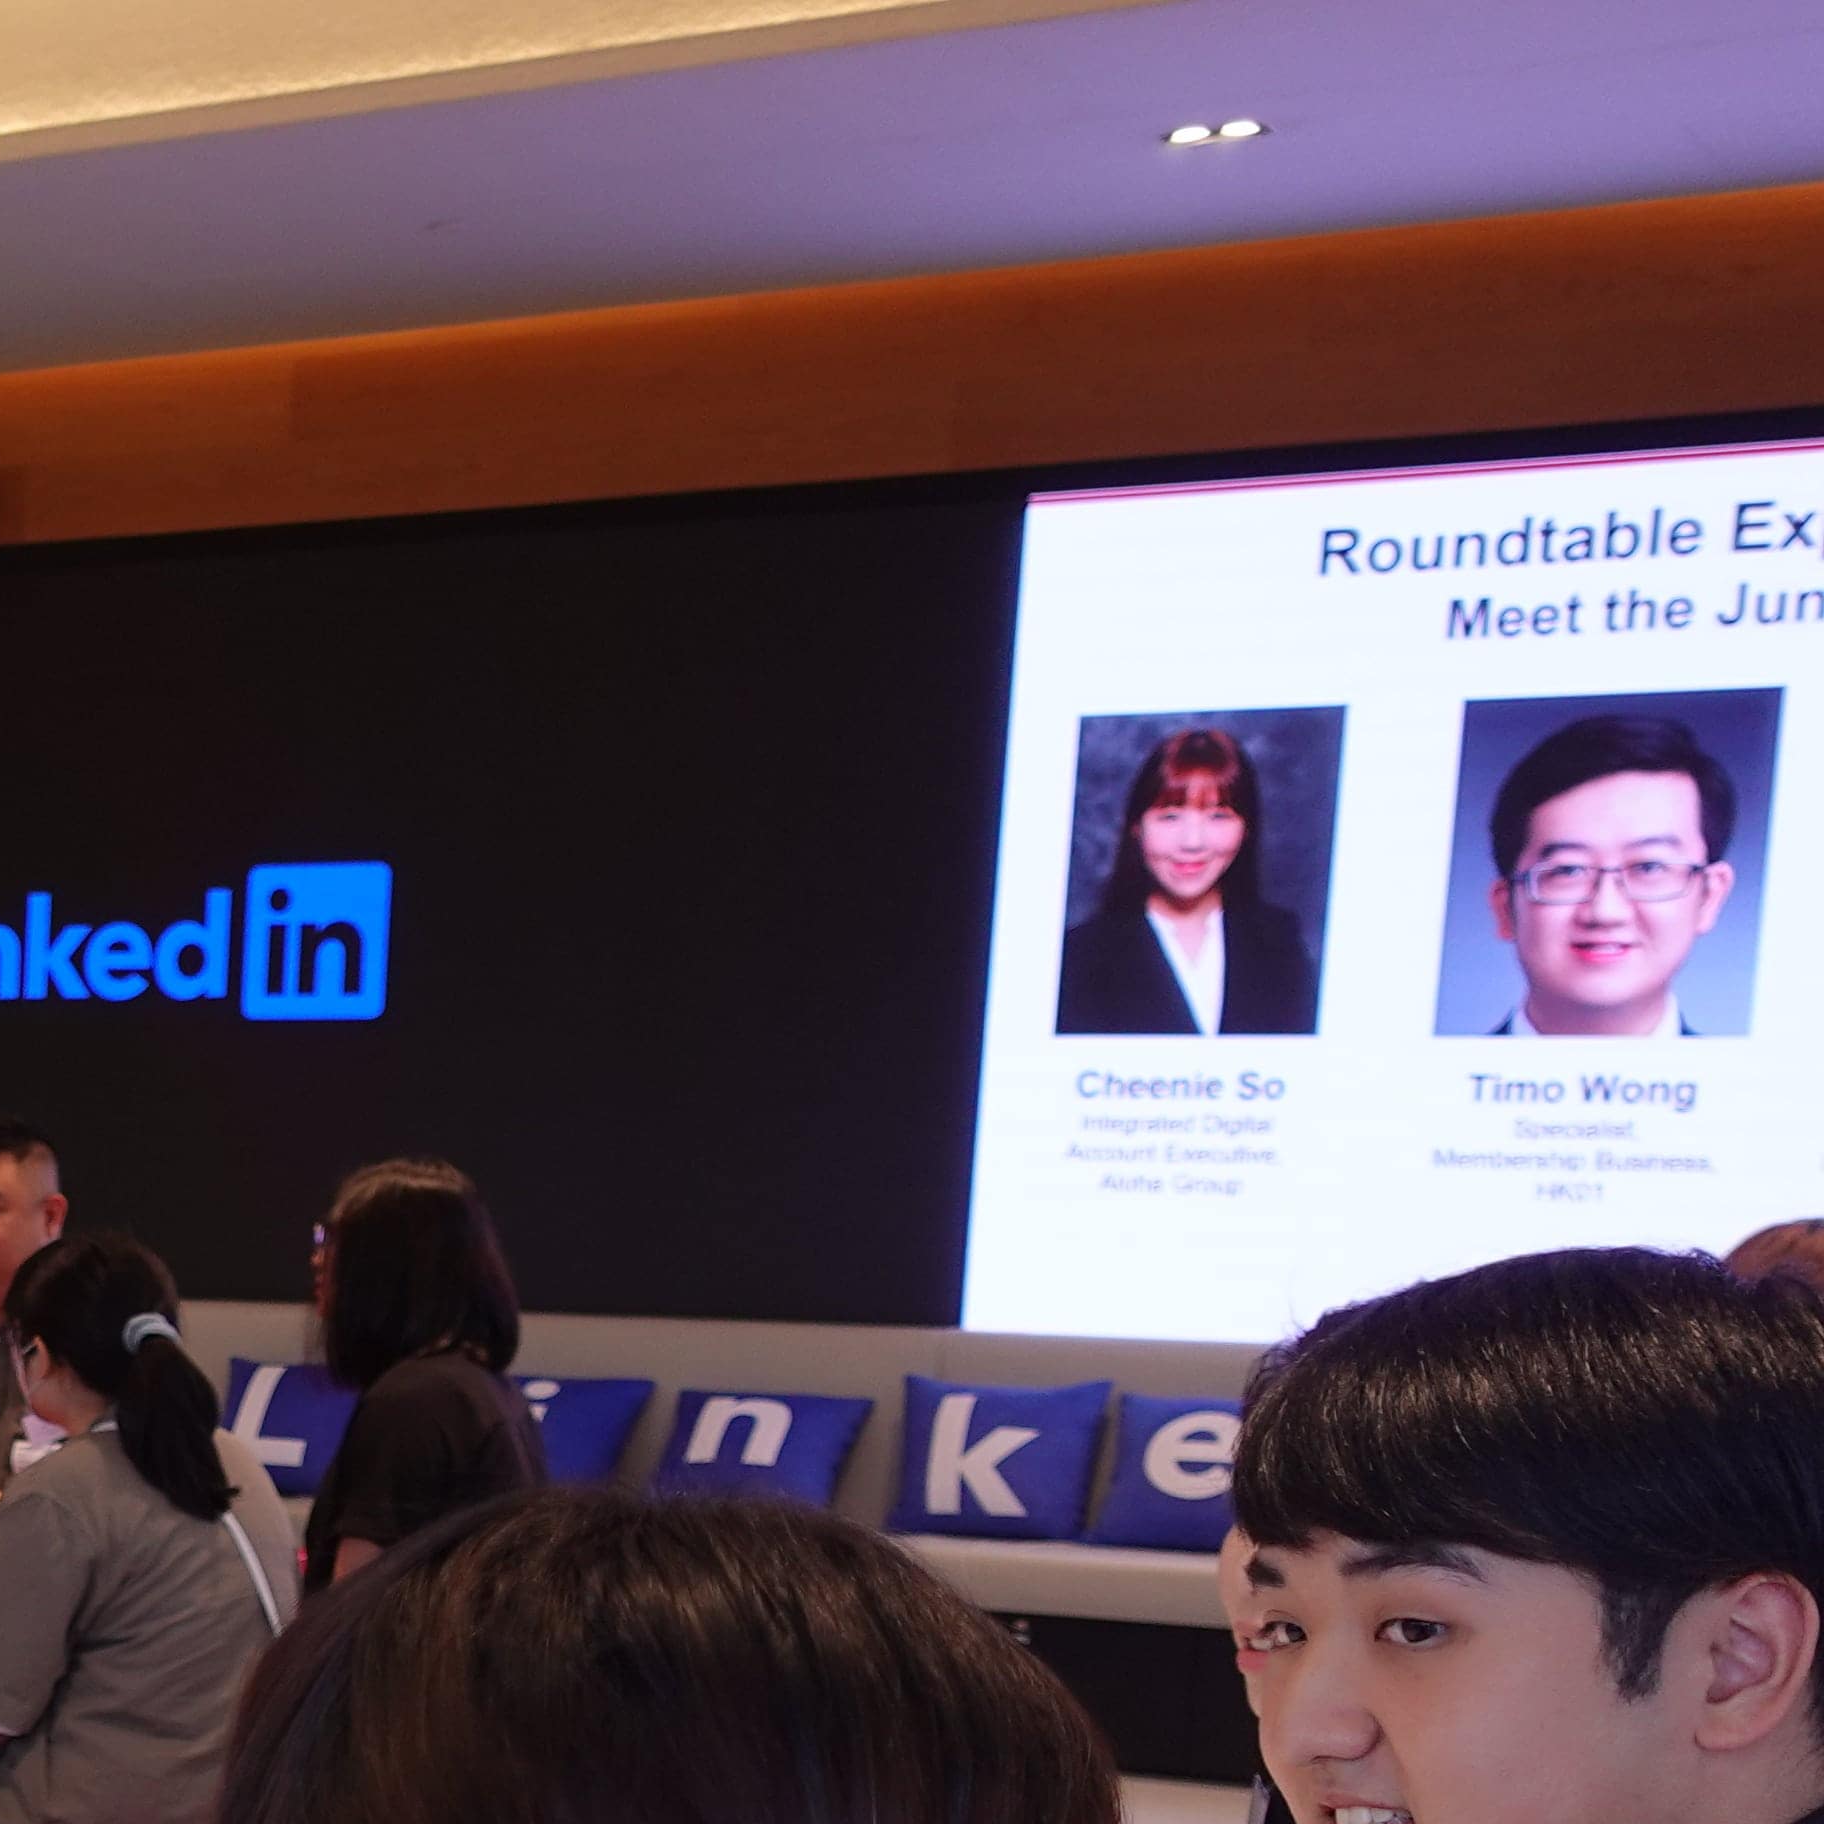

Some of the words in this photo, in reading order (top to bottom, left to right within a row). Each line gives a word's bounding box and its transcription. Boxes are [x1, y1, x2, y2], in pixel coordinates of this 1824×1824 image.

[1320, 508, 1702, 575] Roundtable
[1732, 500, 1824, 562] Ex
[1448, 593, 1583, 638] Meet
[1606, 588, 1694, 631] the
[1076, 1069, 1223, 1099] Cheenie
[1238, 1069, 1286, 1100] So
[1470, 1073, 1565, 1103] Timo
[1581, 1074, 1699, 1112] Wong
